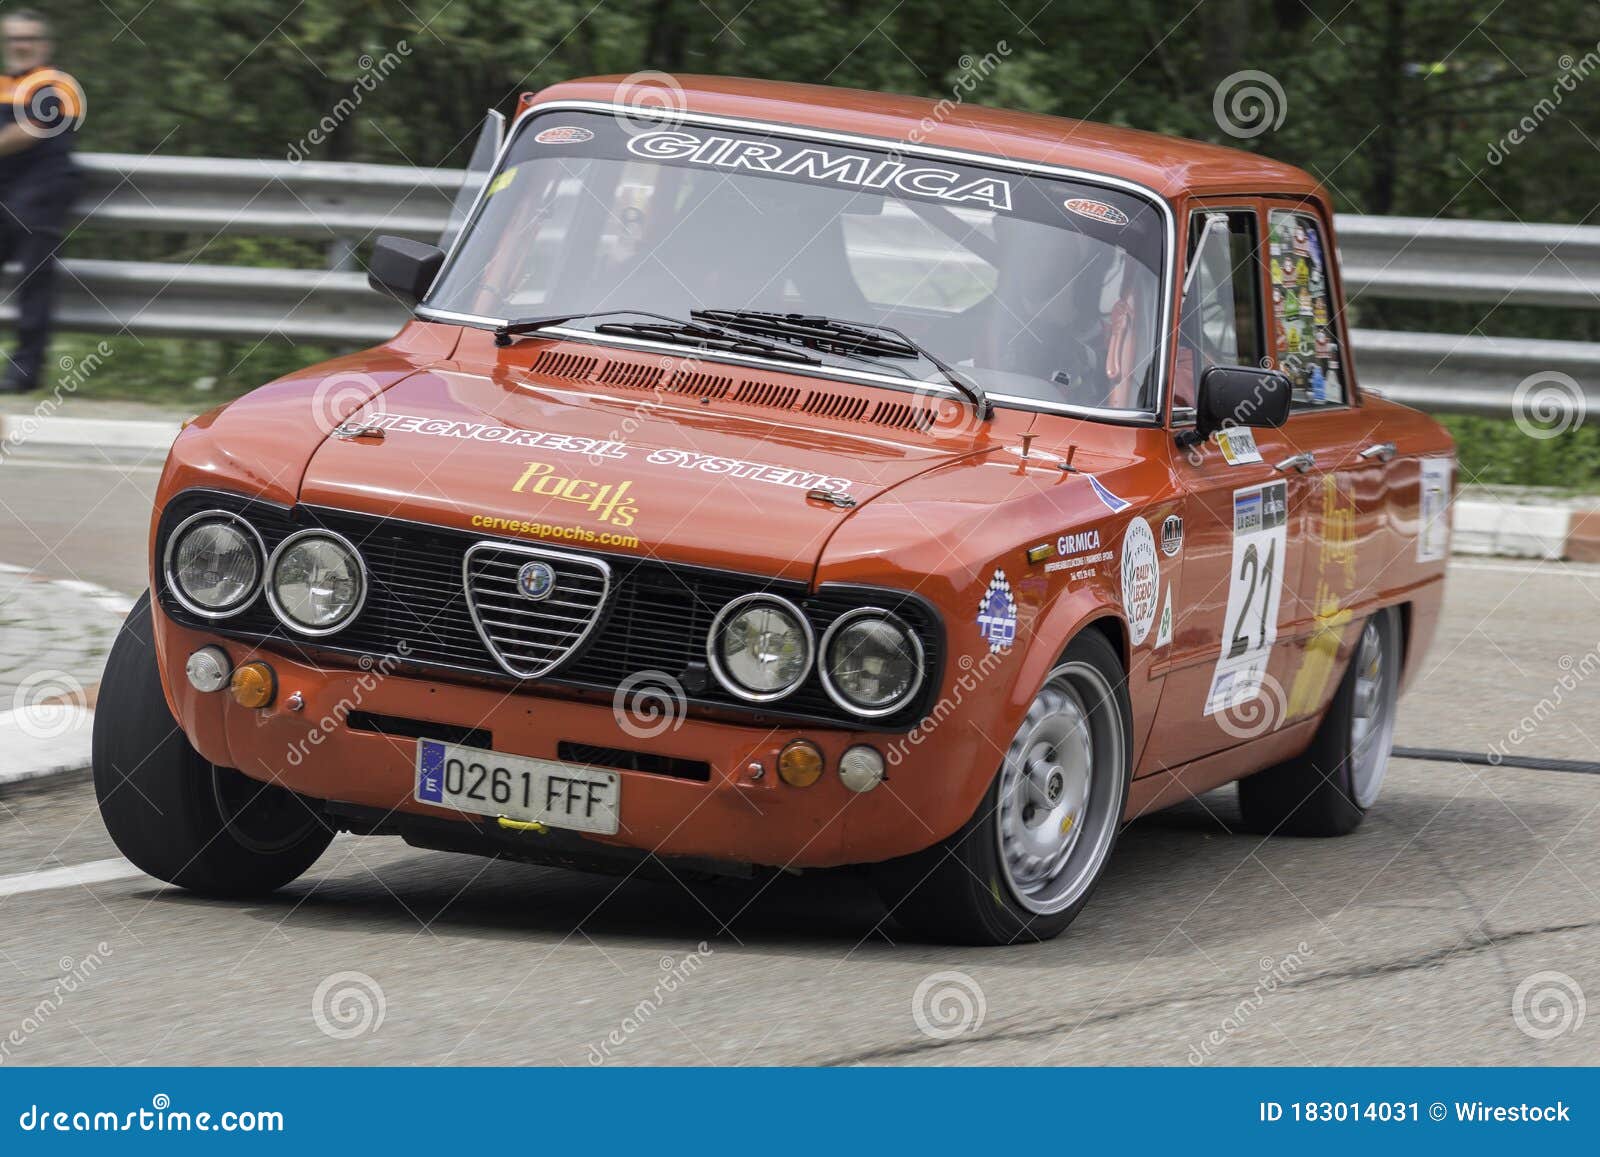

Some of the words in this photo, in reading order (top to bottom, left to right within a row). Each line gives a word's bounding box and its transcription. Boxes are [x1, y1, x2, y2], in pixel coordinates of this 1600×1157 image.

[626, 131, 1012, 211] GIRMICA
[364, 412, 628, 460] TECNORESIL
[646, 449, 852, 497] SYSTEMS
[472, 514, 639, 549] cervesapochs.com
[1057, 529, 1100, 556] GIRMICA
[1132, 581, 1153, 603] LEGEND
[1227, 537, 1276, 660] 21
[1135, 603, 1148, 621] CUP
[426, 778, 437, 793] E
[445, 758, 531, 808] 0261
[546, 775, 608, 818] FFF
